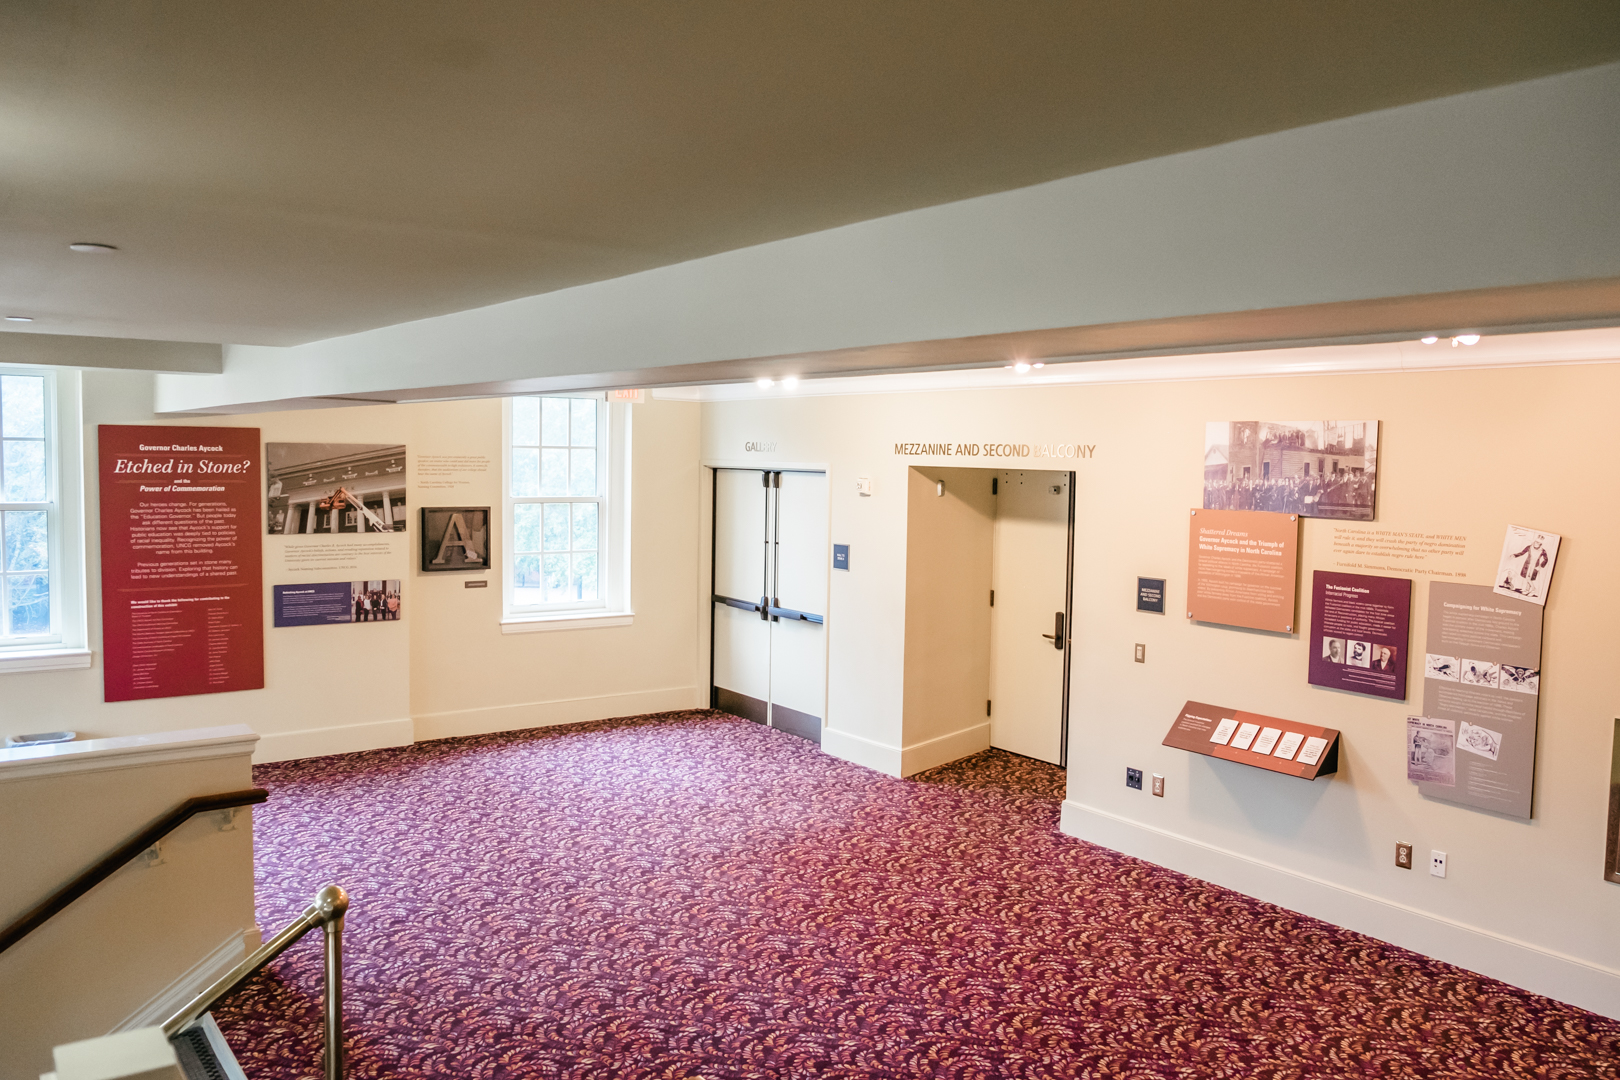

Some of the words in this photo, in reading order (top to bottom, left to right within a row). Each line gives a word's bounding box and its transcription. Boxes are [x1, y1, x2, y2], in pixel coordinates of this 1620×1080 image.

[745, 441, 777, 452] GALLERY
[894, 444, 952, 456] MEZZANINE
[955, 444, 980, 456] AND
[983, 444, 1030, 457] SECOND
[1034, 444, 1096, 458] BALCONY
[114, 459, 174, 474] Etched
[177, 460, 193, 473] in
[198, 459, 250, 474] Stone?
[432, 513, 483, 564] A
[1214, 545, 1239, 553] Supremacy
[1444, 602, 1472, 610] Campaigning
[1495, 607, 1521, 616] Supremacy
